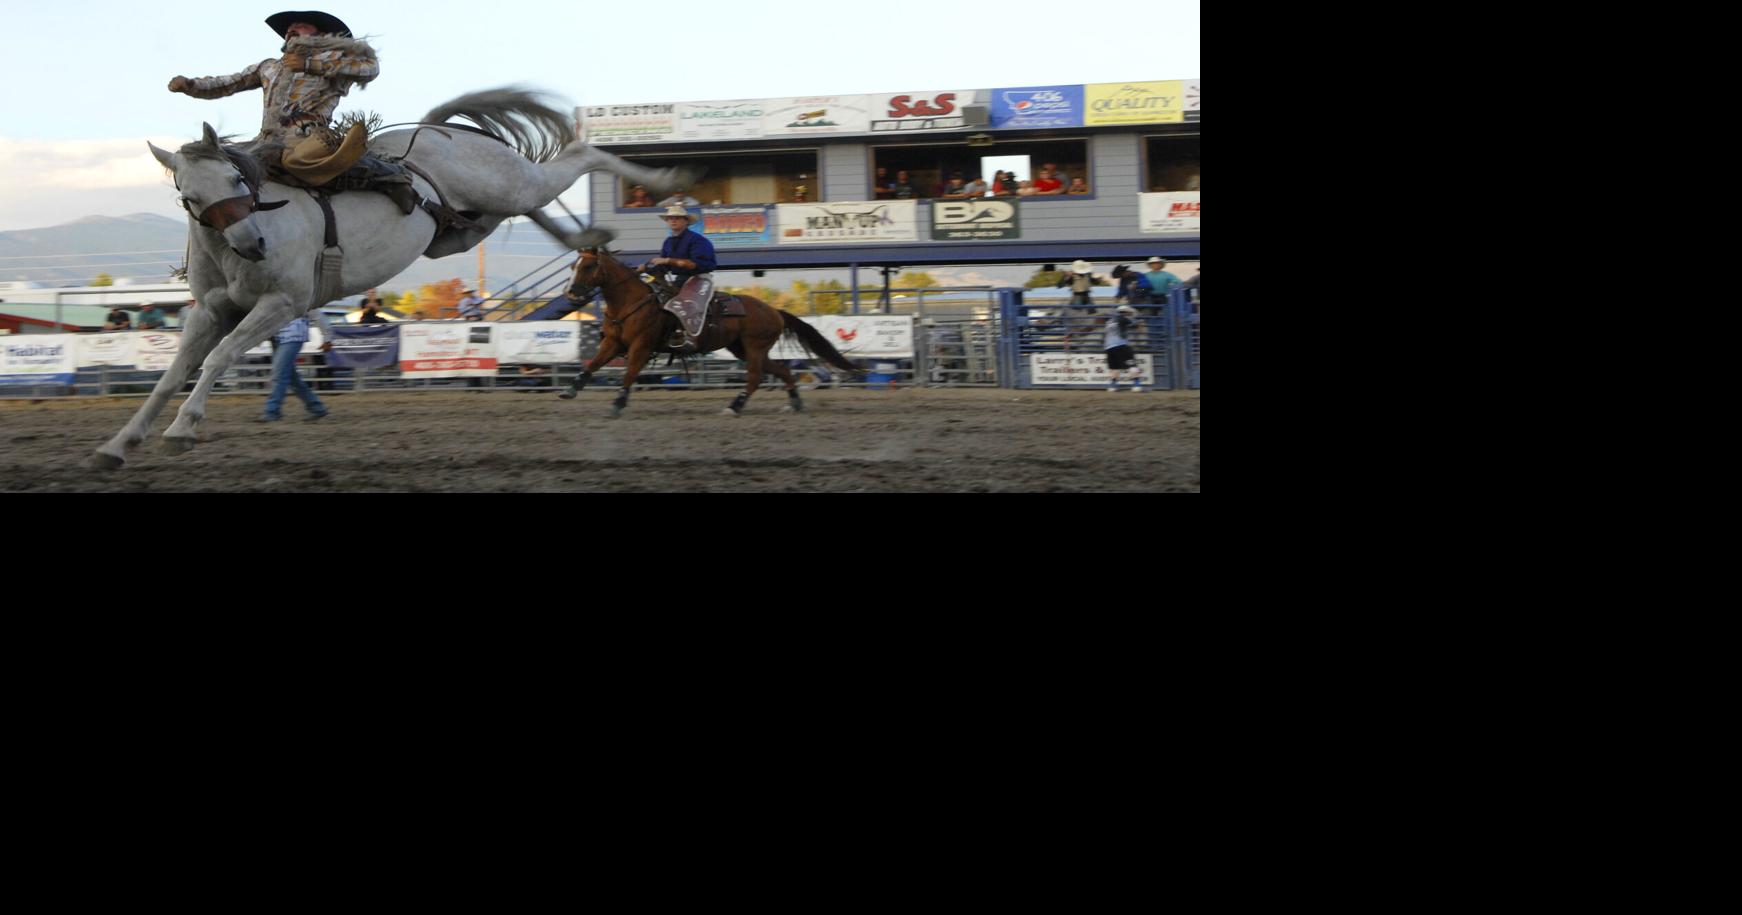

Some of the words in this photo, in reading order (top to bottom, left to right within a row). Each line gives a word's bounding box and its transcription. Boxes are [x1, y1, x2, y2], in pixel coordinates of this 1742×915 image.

[611, 104, 674, 116] CUSTOM
[888, 93, 956, 118] S&S
[1091, 96, 1176, 112] QUALITY
[680, 109, 763, 119] LAKELAND
[7, 344, 64, 356] Habitat
[1036, 356, 1084, 365] Larry's
